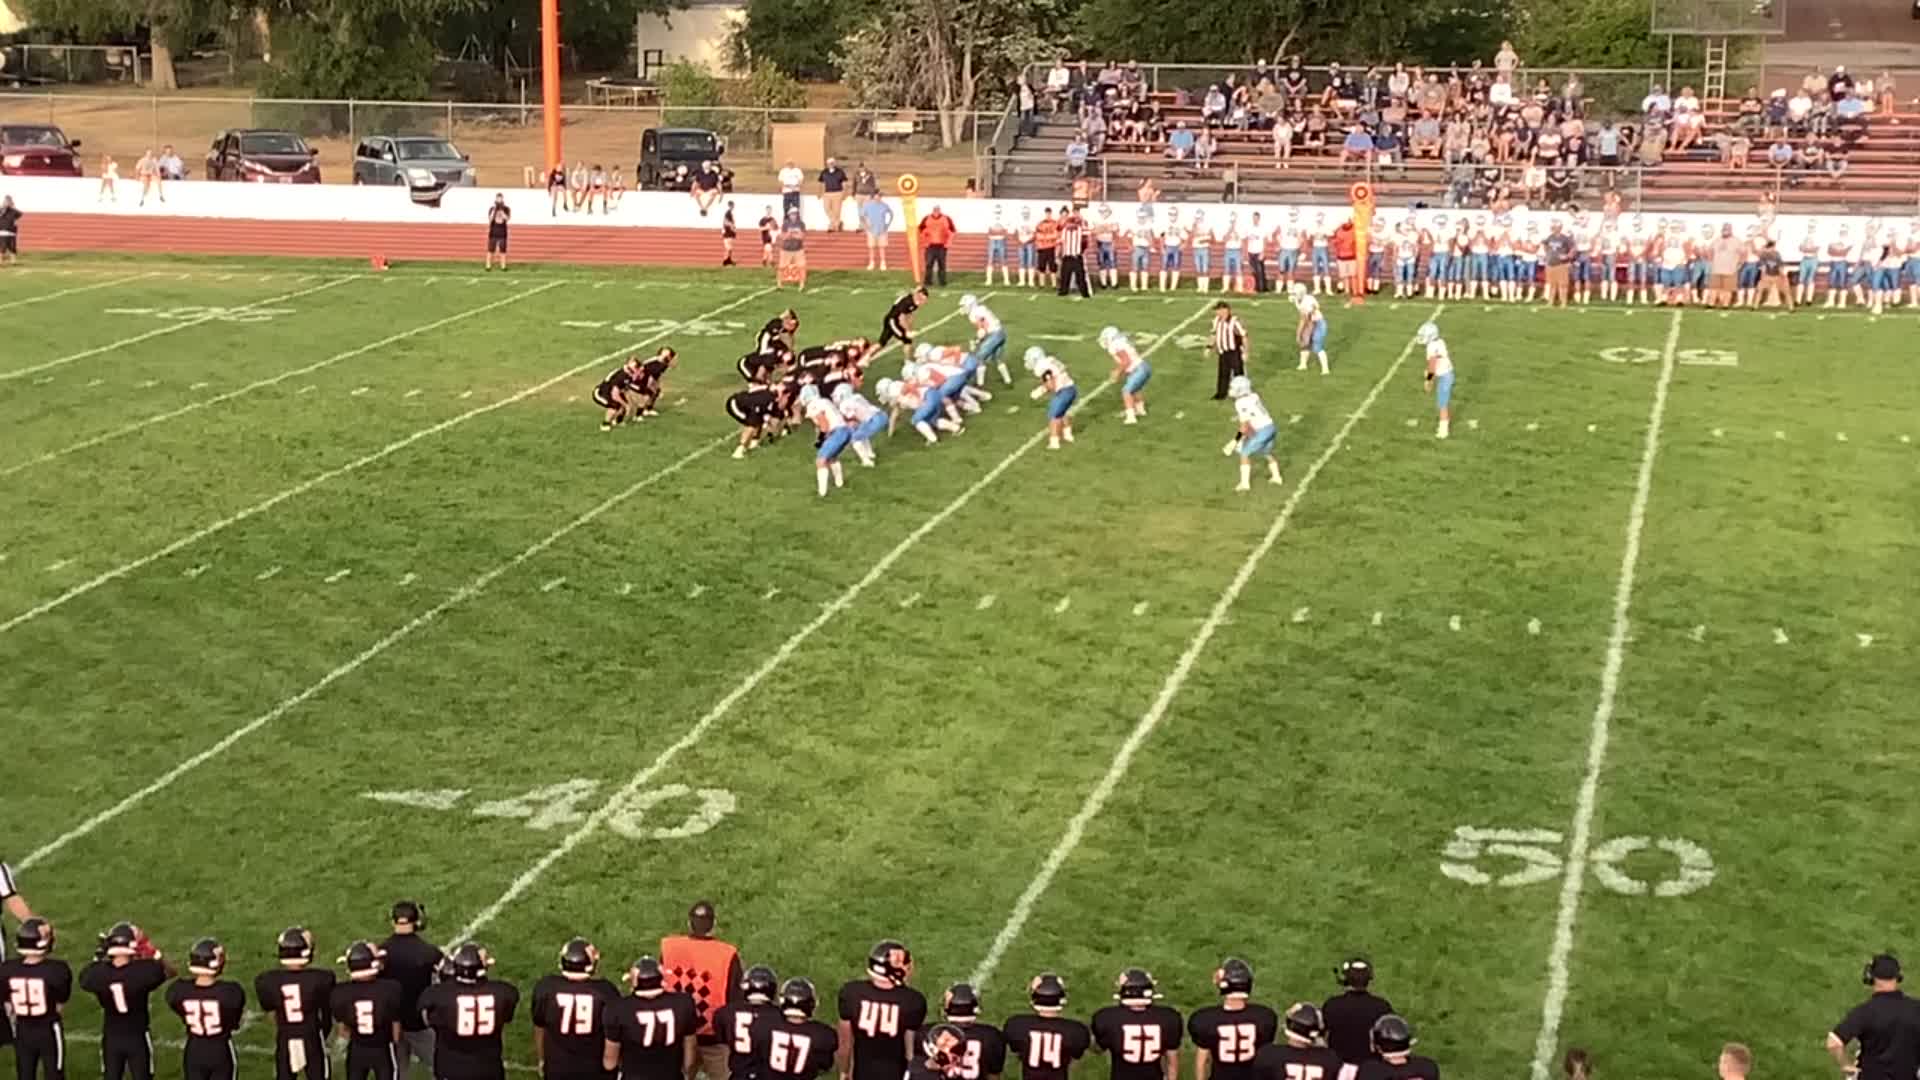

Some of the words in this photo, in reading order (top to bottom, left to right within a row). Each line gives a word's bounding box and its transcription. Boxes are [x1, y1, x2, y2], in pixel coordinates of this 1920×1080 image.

[472, 778, 736, 840] 40
[1440, 825, 1716, 896] 50
[9, 977, 47, 1017] 29
[110, 982, 128, 1014] 1
[281, 983, 304, 1023] 2
[457, 995, 495, 1036] 65
[556, 993, 594, 1035] 79
[182, 999, 223, 1037] 32
[355, 1000, 374, 1035] 5
[636, 1009, 675, 1047] 77
[735, 1011, 758, 1054] 5
[858, 1000, 899, 1037] 44
[769, 1030, 811, 1074] 67
[1029, 1031, 1062, 1068] 14
[1122, 1024, 1161, 1063] 52
[1217, 1023, 1256, 1062] 23
